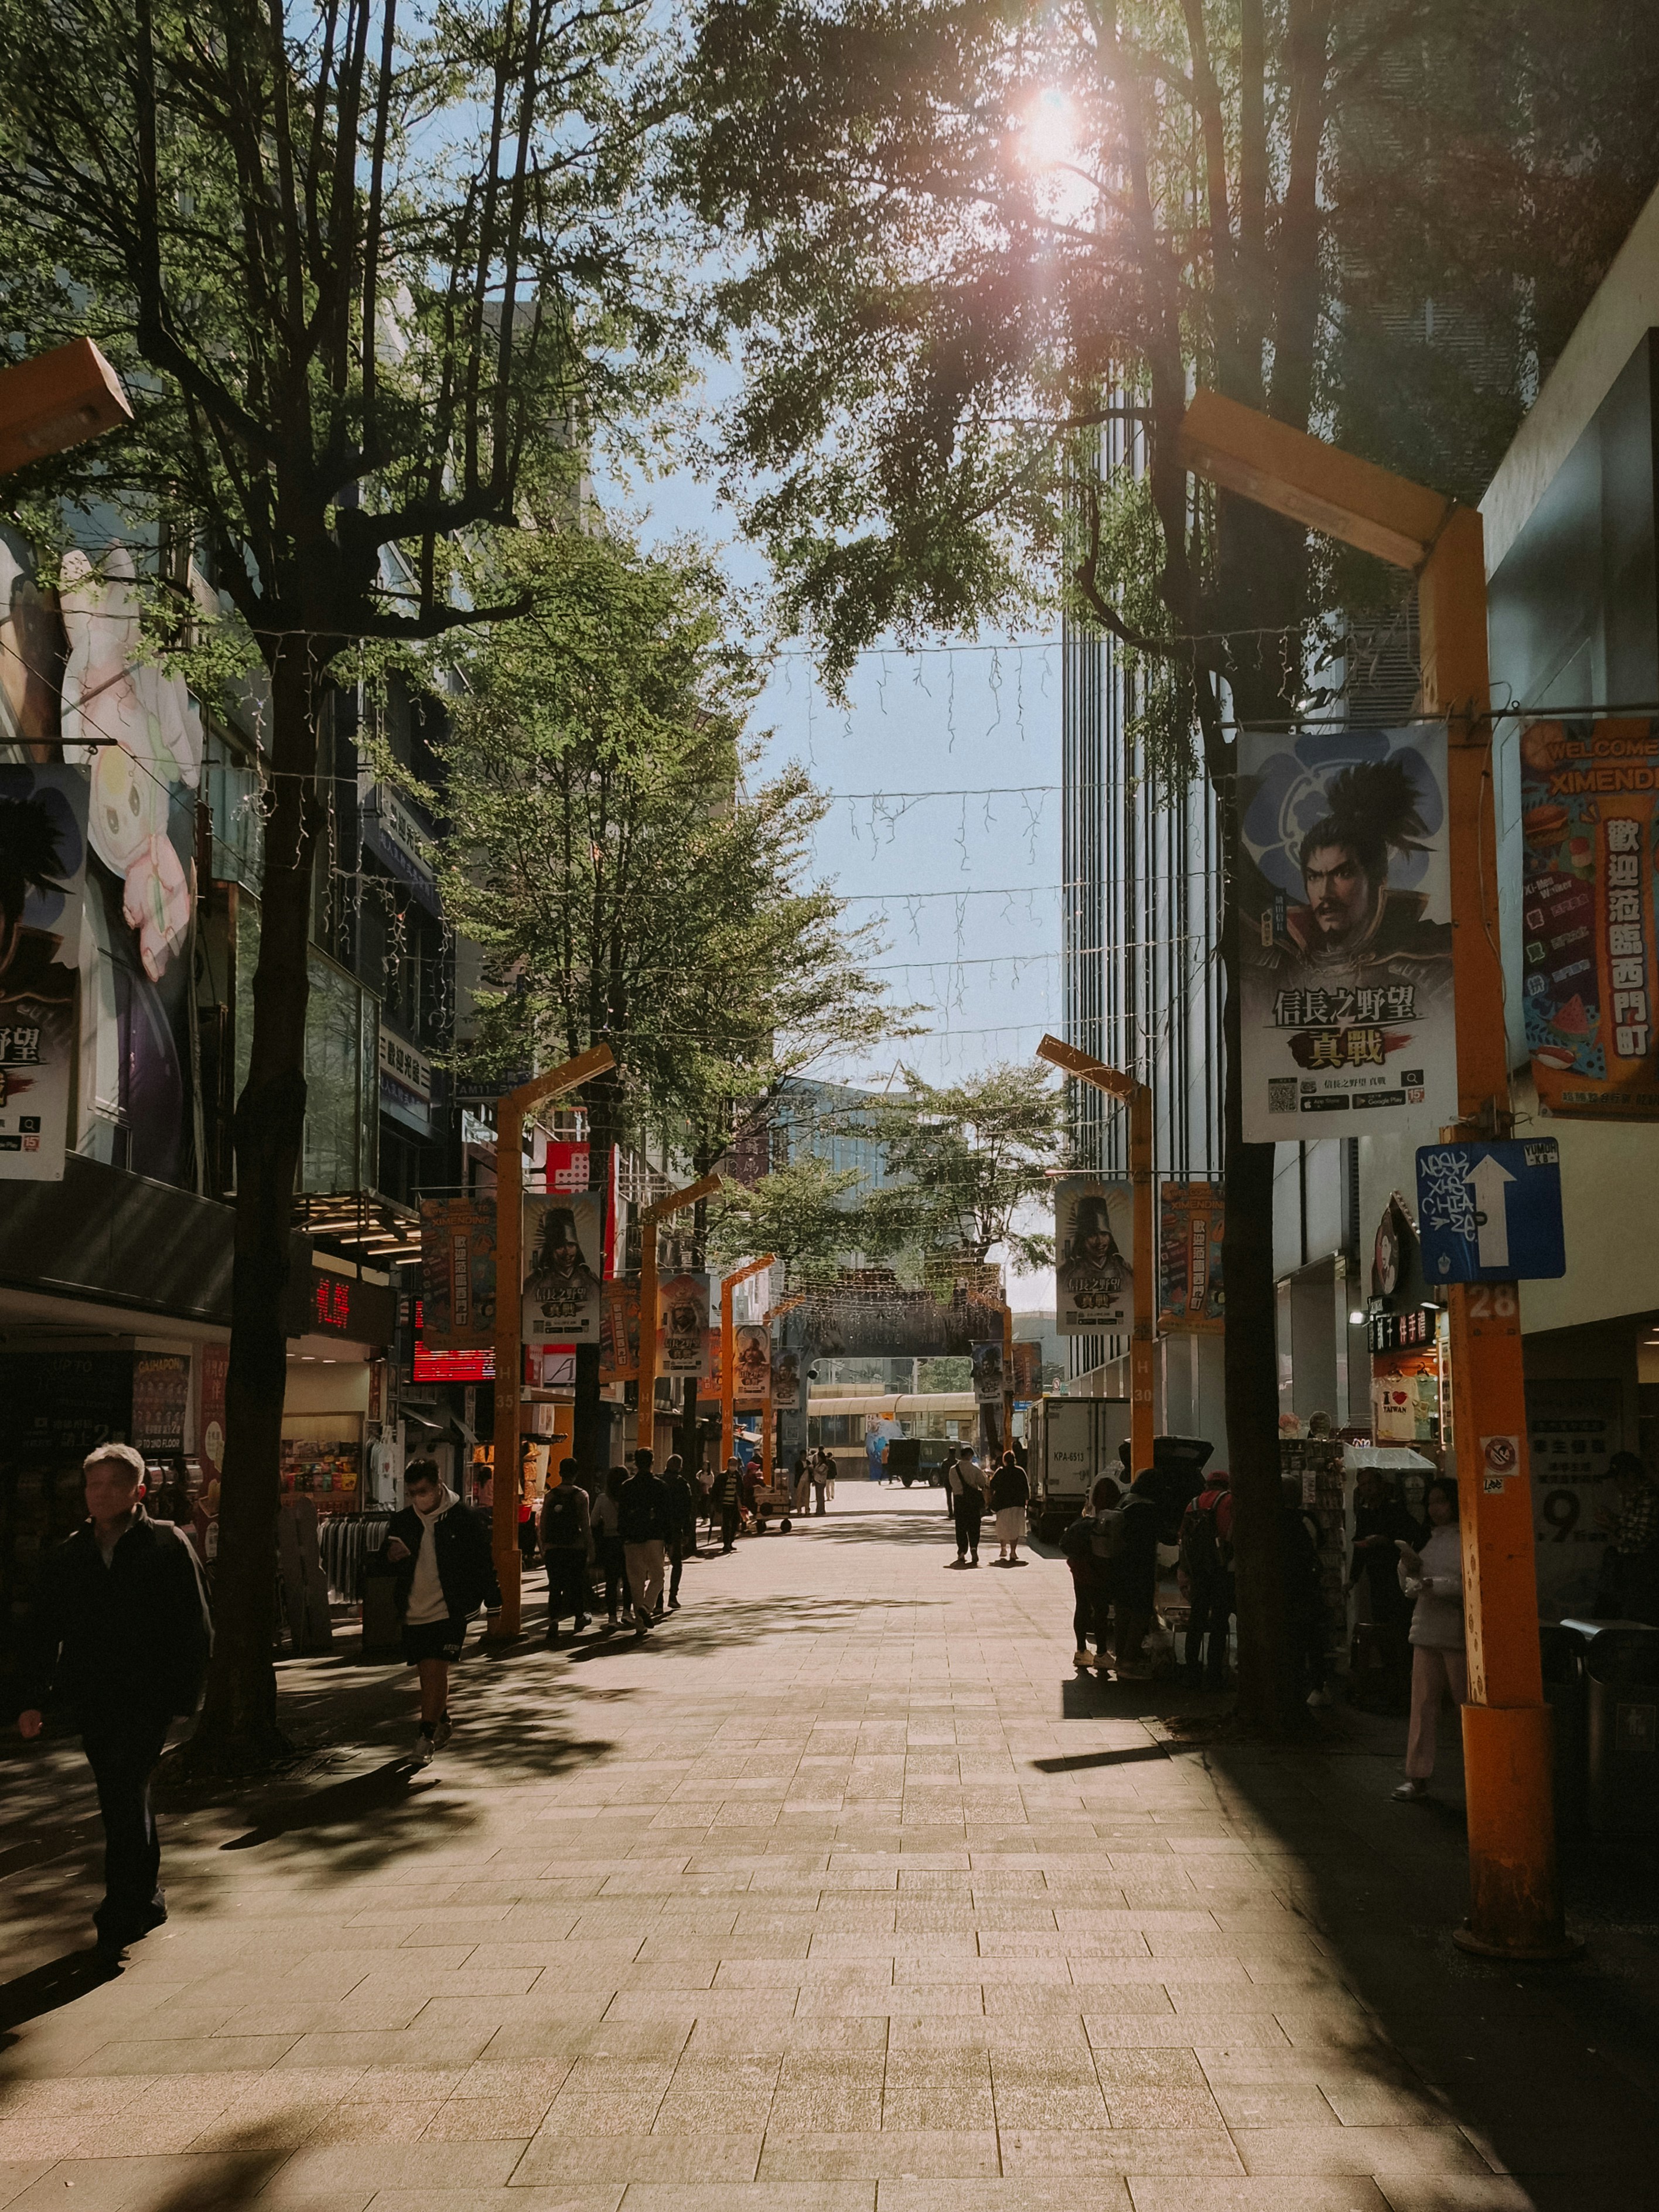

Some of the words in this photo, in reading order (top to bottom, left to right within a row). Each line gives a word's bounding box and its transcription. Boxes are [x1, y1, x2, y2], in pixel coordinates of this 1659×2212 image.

[1548, 738, 1659, 761] WELCOME
[1274, 984, 1415, 1025] 信長之野望
[1309, 1027, 1385, 1069] 真戰
[1324, 1078, 1366, 1089] 信長之野望
[432, 1216, 490, 1226] XIMENDING
[499, 1366, 511, 1379] H
[547, 1357, 576, 1381] A
[1137, 1360, 1148, 1373] H
[496, 1395, 514, 1407] 35
[1134, 1389, 1152, 1401] 30
[1383, 1391, 1390, 1405] I
[162, 1439, 180, 1448] FLOOR
[1054, 1452, 1084, 1462] KPA-6513
